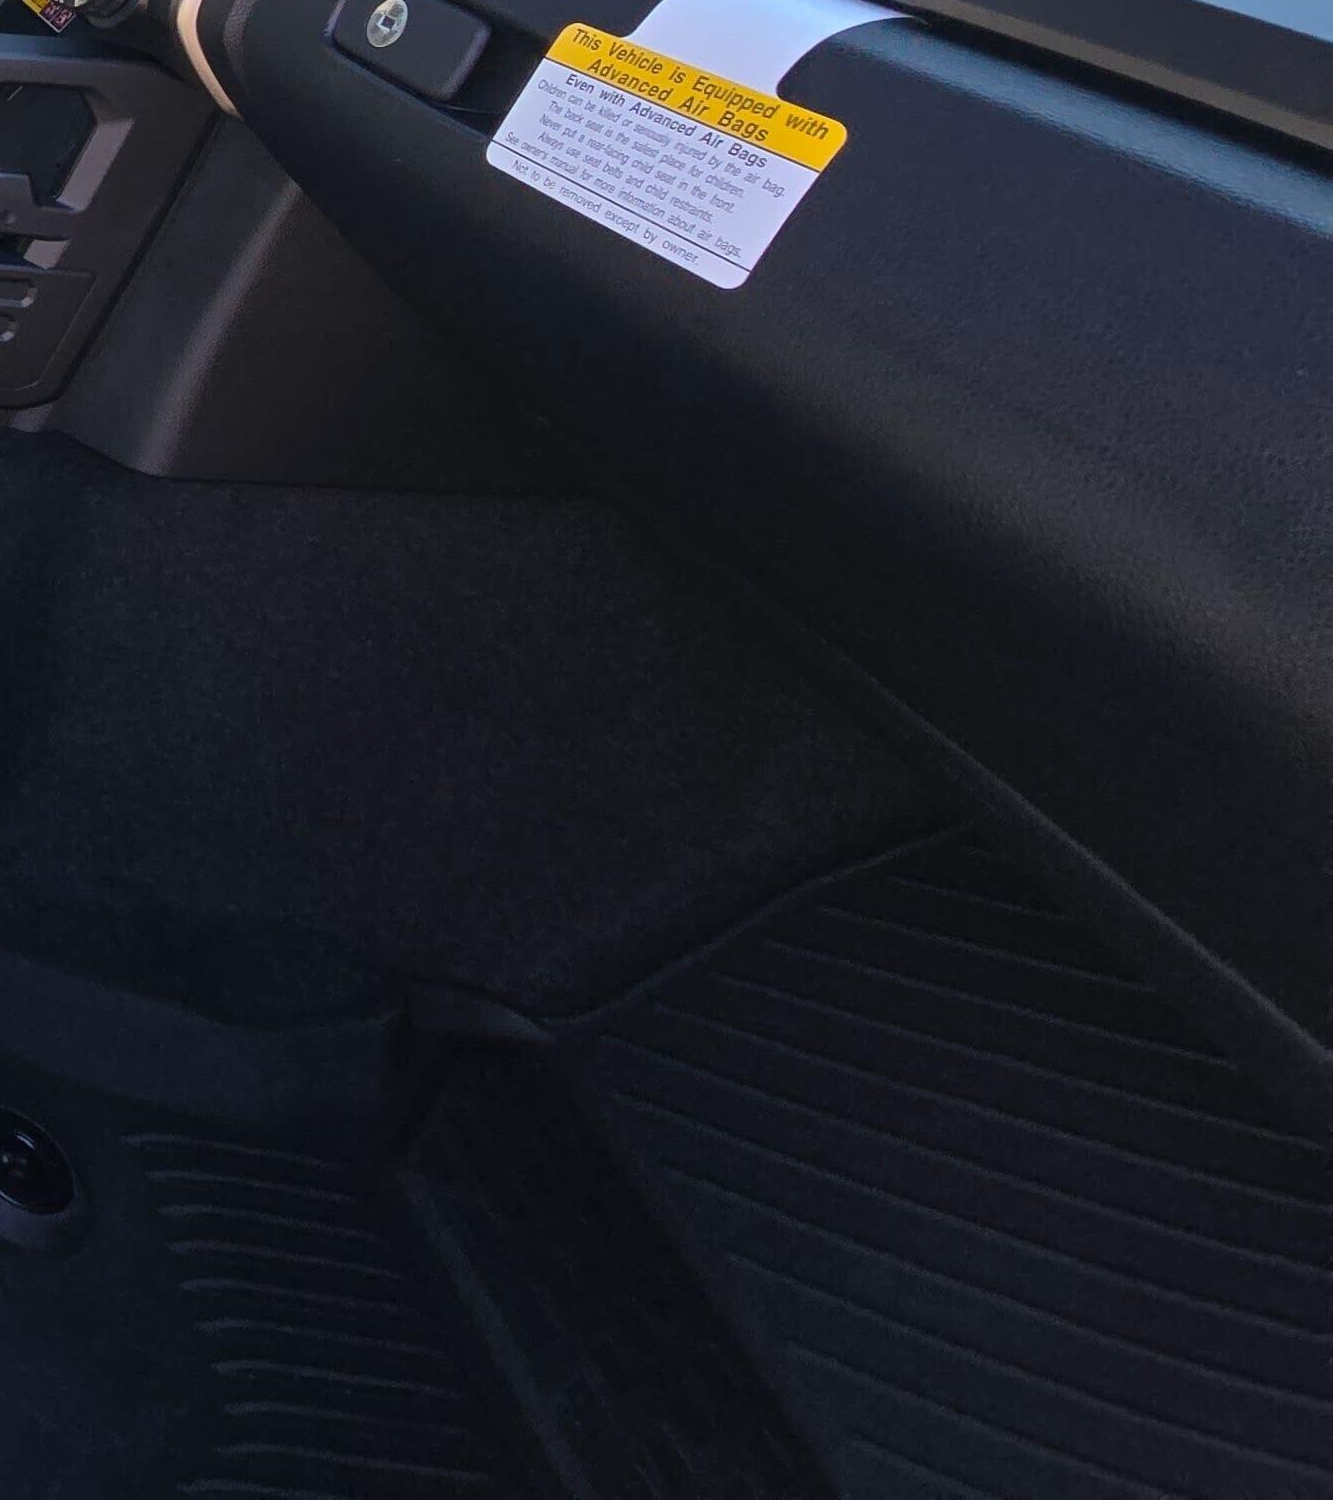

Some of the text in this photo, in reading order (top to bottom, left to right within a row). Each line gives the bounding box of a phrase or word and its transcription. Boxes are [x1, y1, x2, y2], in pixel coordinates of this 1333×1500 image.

[565, 73, 768, 169] Even with Advanced Air Bags
[572, 28, 829, 140] This Vehicle is Equipped with
[587, 58, 769, 142] Advanced Air Bags
[537, 79, 567, 100] Children
[567, 94, 584, 106] can
[584, 100, 596, 112] be
[621, 118, 633, 127] or
[707, 155, 723, 170] by
[724, 162, 741, 176] the
[743, 172, 761, 184] air
[761, 178, 785, 198] bag.
[537, 131, 565, 150] Always
[565, 145, 581, 158] use
[583, 154, 602, 168] seat
[602, 162, 624, 179] belts
[625, 174, 645, 189] and
[645, 183, 669, 201] child
[539, 113, 563, 131] Never
[561, 127, 578, 139] put
[631, 158, 654, 175] child
[654, 169, 677, 186] seat
[677, 179, 688, 190] in
[690, 185, 707, 200] the
[548, 100, 563, 114] The
[564, 107, 584, 124] back
[585, 119, 604, 134] seat
[605, 126, 614, 138] is
[615, 132, 630, 145] the
[658, 153, 686, 171] place
[687, 164, 703, 178] for
[505, 132, 519, 146] See
[579, 168, 593, 181] for
[594, 178, 615, 193] more
[617, 187, 665, 218] information
[667, 214, 696, 234] about
[697, 228, 713, 241] air
[714, 236, 741, 259] bags.
[511, 160, 699, 266] Not to be removed except by owner.
